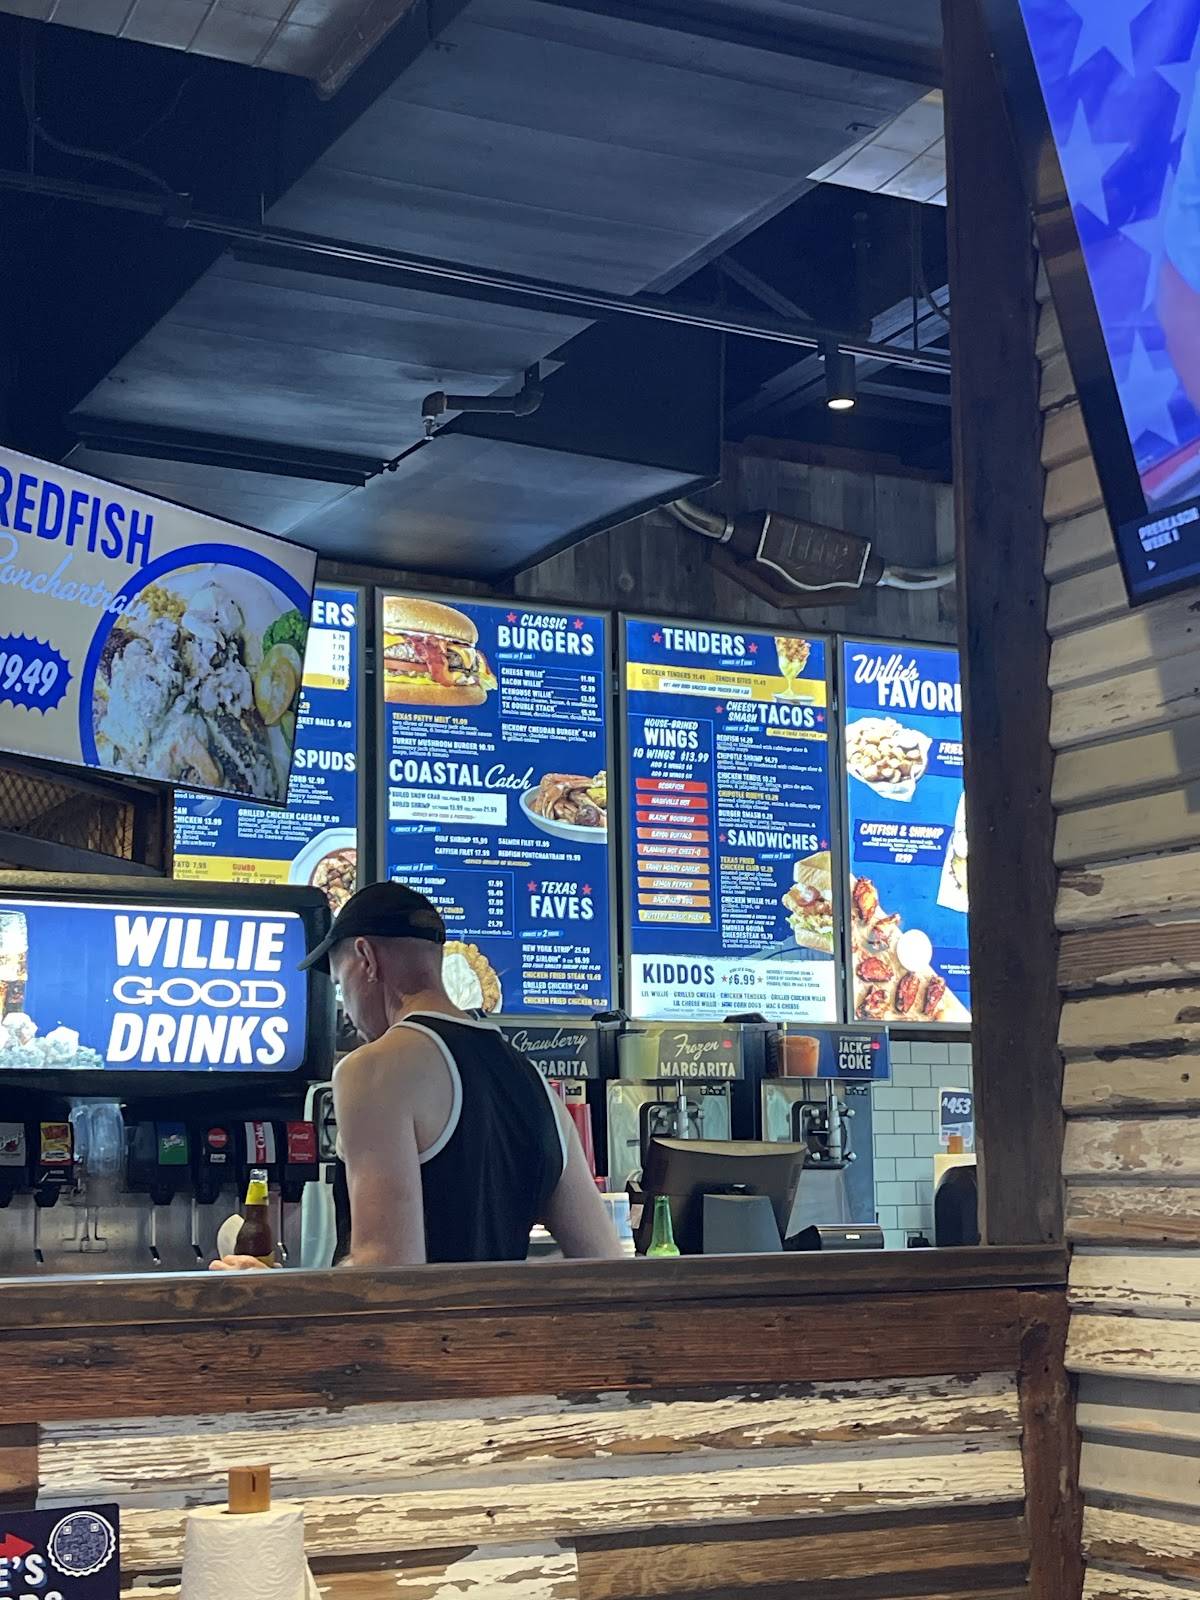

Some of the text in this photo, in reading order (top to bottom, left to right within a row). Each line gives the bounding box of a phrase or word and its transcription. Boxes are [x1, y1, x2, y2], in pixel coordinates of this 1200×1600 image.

[0, 465, 153, 568] REDFISH
[501, 567, 523, 576] CHEESE
[521, 613, 567, 630] CLASSIC
[498, 625, 594, 656] BURGERS
[662, 628, 746, 657] TENDERS
[852, 654, 919, 684] Willie's
[501, 677, 522, 686] BACON
[726, 701, 757, 713] CHEESY
[758, 703, 815, 728] TACOS
[501, 723, 527, 732] HICKORY
[728, 712, 757, 723] SMASH
[392, 737, 478, 750] TURKEY MUSHROOM BURGER
[644, 727, 699, 749] WINGS
[294, 748, 356, 772] SPUDS
[633, 748, 709, 763] 10 WINGS $13.99
[389, 758, 534, 790] COASTAL Catch
[238, 809, 265, 818] GRILLED
[266, 811, 295, 820] CHICKEN
[295, 813, 322, 822] CAESAR
[418, 825, 424, 833] 2
[860, 822, 944, 840] CATFISH & SHRIMP
[727, 829, 819, 851] SANDWICHES
[541, 881, 578, 895] TEXAS
[531, 895, 594, 920] FAVES
[114, 915, 287, 972] WILLIE
[642, 963, 716, 986] KIDDOS
[728, 973, 756, 987] $6.99
[113, 976, 287, 1009] GOOD
[547, 982, 573, 991] CHICKEN
[106, 1012, 289, 1065] DRINKS
[511, 1028, 588, 1054] Strawberry
[673, 1033, 719, 1060] Frozen
[838, 1042, 863, 1054] JACK
[660, 1062, 736, 1077] MARGARITA
[839, 1054, 871, 1070] COKE
